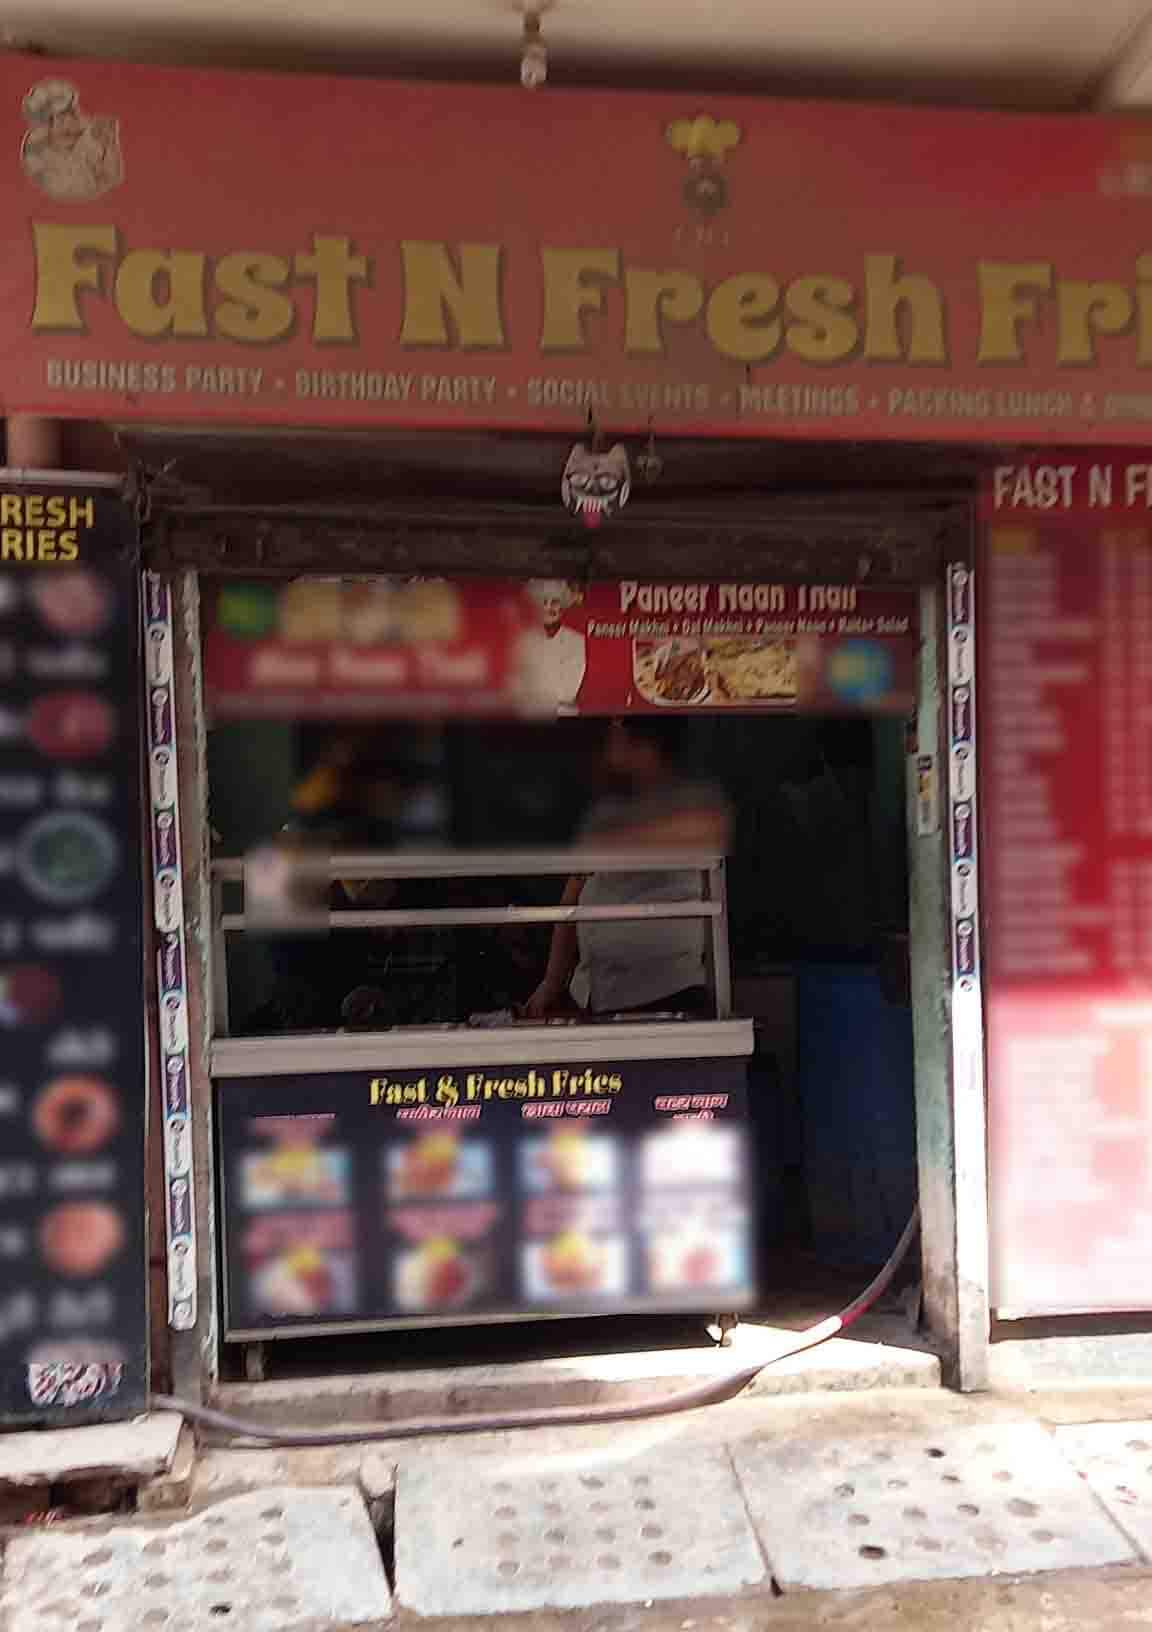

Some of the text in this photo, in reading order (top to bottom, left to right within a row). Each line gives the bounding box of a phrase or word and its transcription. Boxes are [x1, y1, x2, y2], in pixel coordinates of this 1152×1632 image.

[31, 223, 367, 343] Fast
[400, 240, 504, 347] N
[540, 247, 946, 362] Fresh
[47, 360, 176, 393] BUSINESS
[185, 367, 263, 395] PARTY
[295, 368, 414, 401] BIRTHDAY
[421, 375, 497, 404] PARTY
[1087, 464, 1112, 508] N
[619, 579, 709, 613] Paneer
[369, 1078, 427, 1105] Fast
[466, 1070, 546, 1100] Fresh
[552, 1068, 623, 1096] Fries
